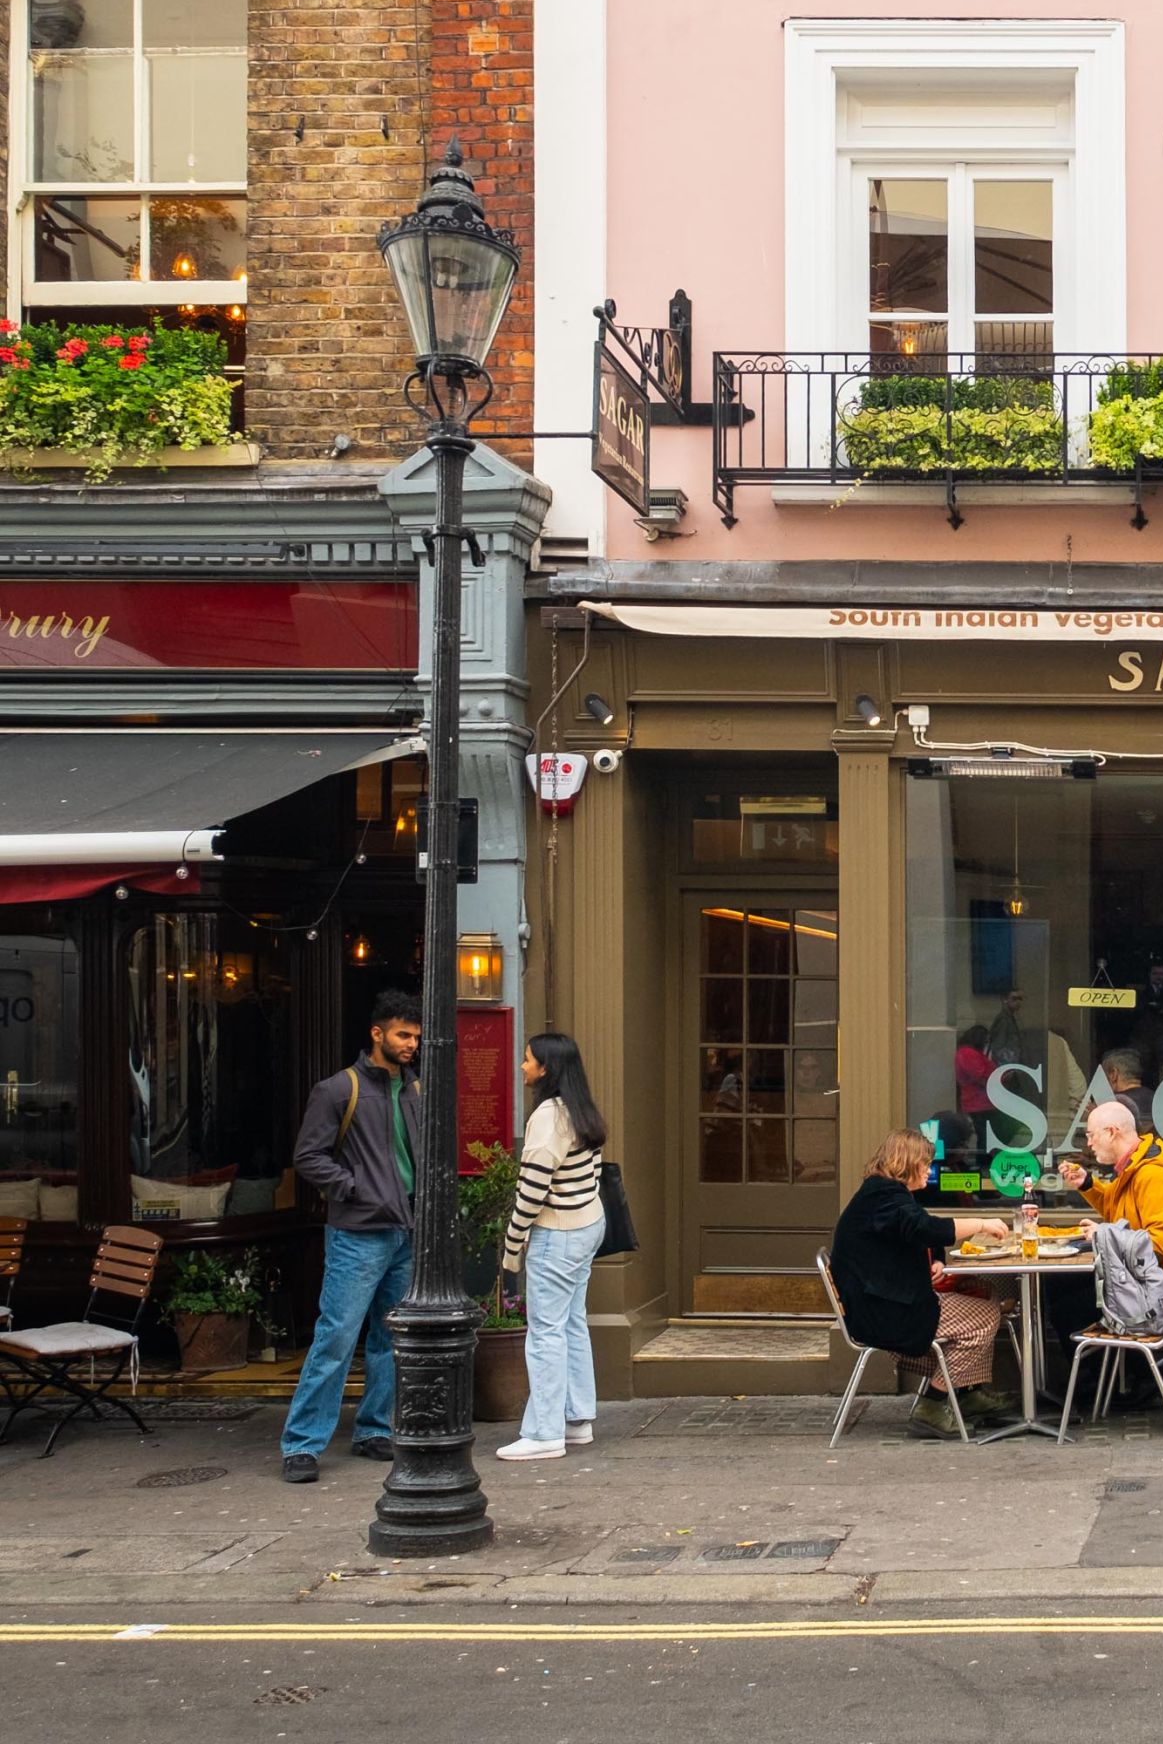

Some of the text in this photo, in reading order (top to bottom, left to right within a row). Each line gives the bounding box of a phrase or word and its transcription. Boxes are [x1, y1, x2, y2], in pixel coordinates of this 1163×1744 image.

[599, 376, 645, 456] SAGAR
[828, 609, 922, 628] South
[935, 611, 1039, 628] Indian
[0, 608, 110, 658] rury
[706, 718, 735, 742] 31
[1080, 991, 1127, 1005] OPEN
[1000, 1161, 1029, 1173] Uber
